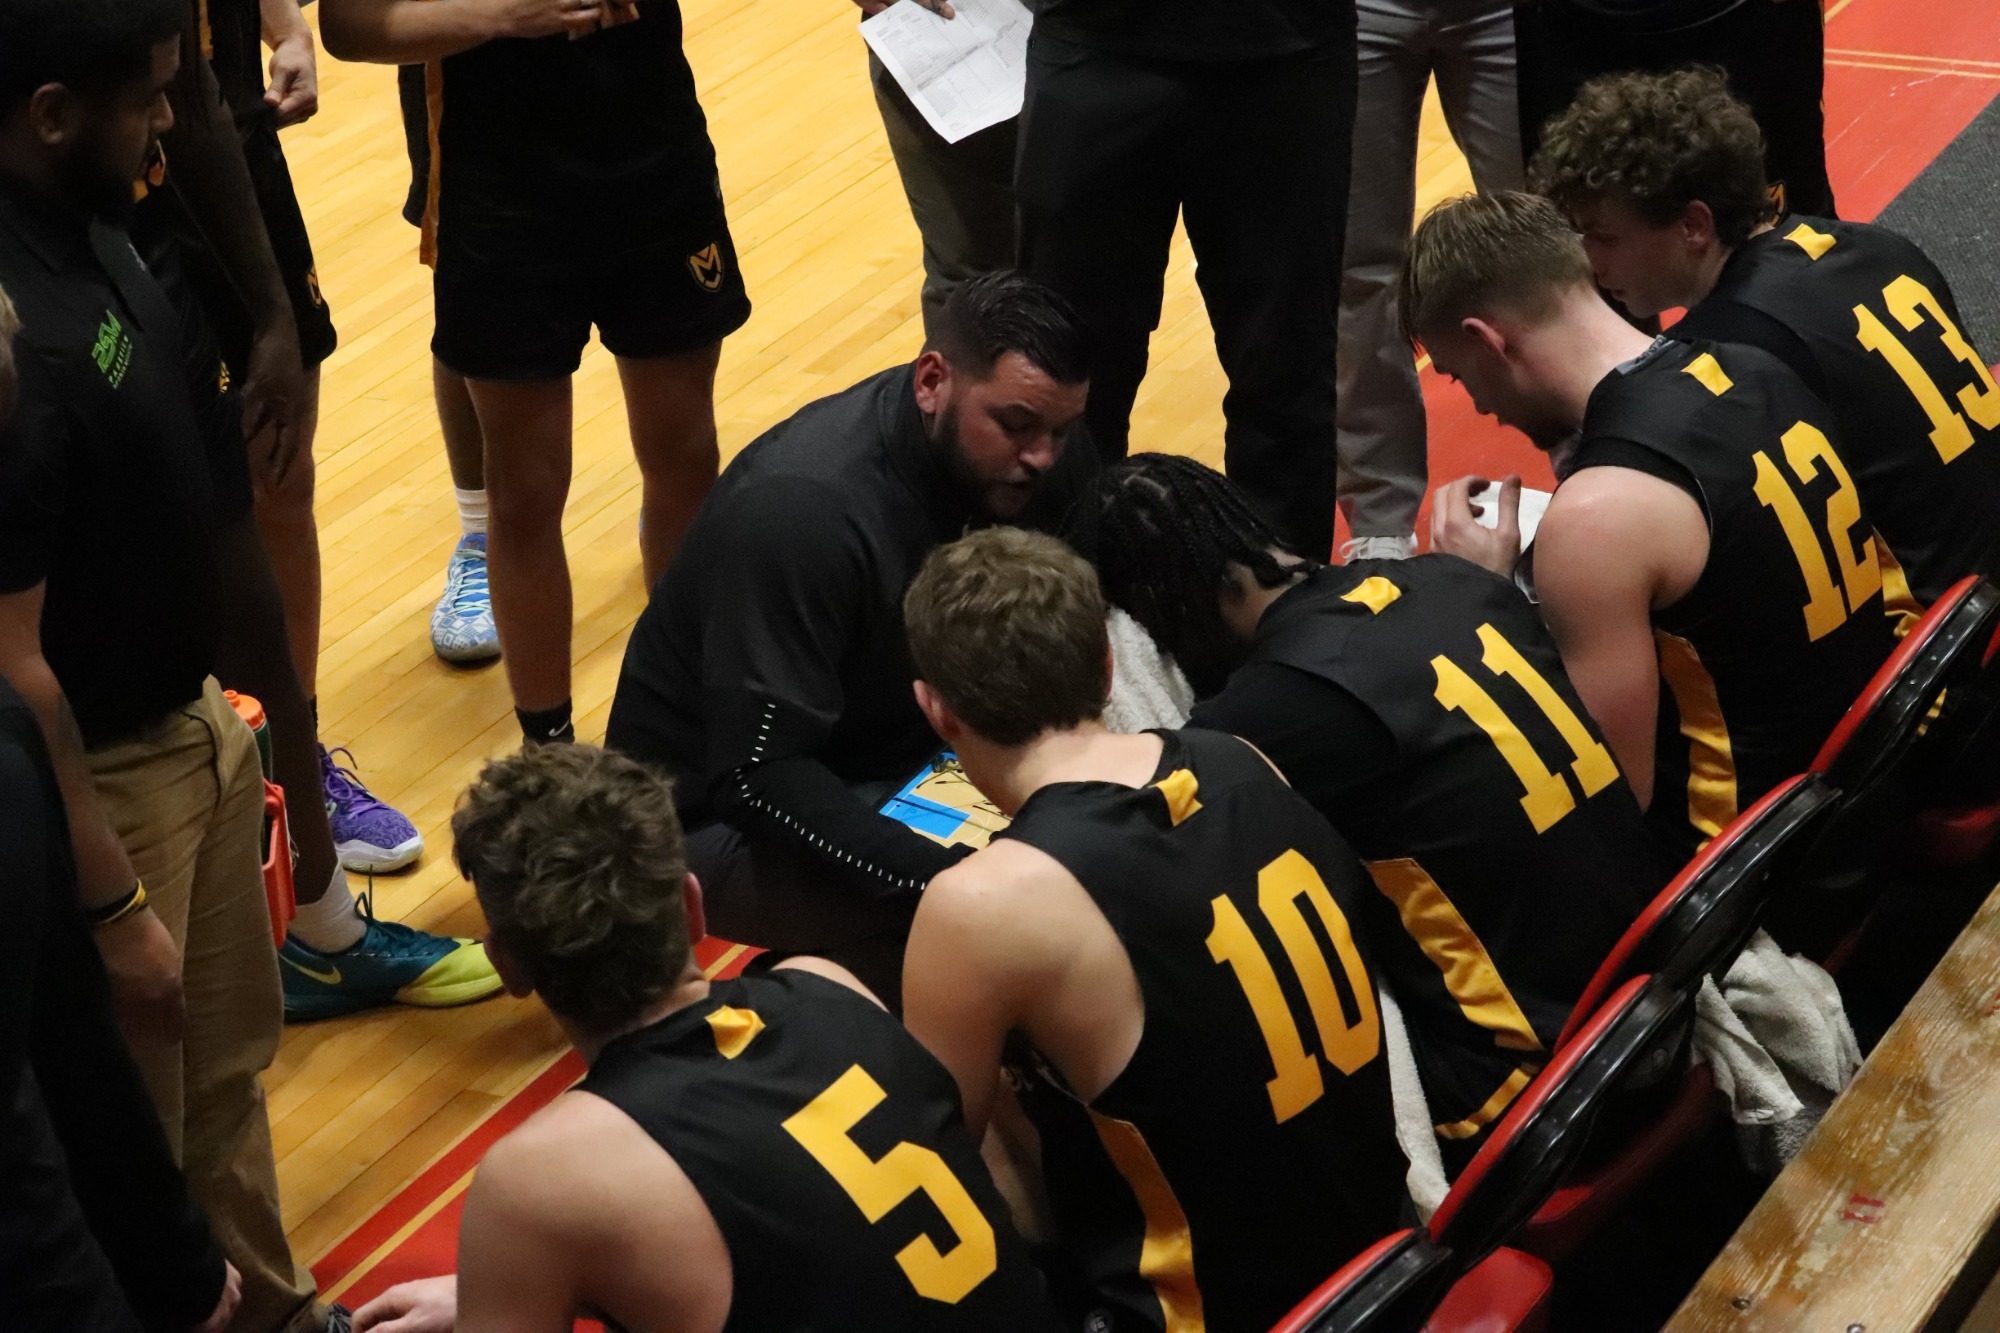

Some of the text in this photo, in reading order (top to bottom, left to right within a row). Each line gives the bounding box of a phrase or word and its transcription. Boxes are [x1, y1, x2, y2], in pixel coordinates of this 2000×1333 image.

[1852, 274, 2000, 465] 13
[1752, 420, 1883, 641] 12
[1431, 622, 1620, 833] 11
[1205, 848, 1381, 1123] 10
[782, 1063, 997, 1304] 5
